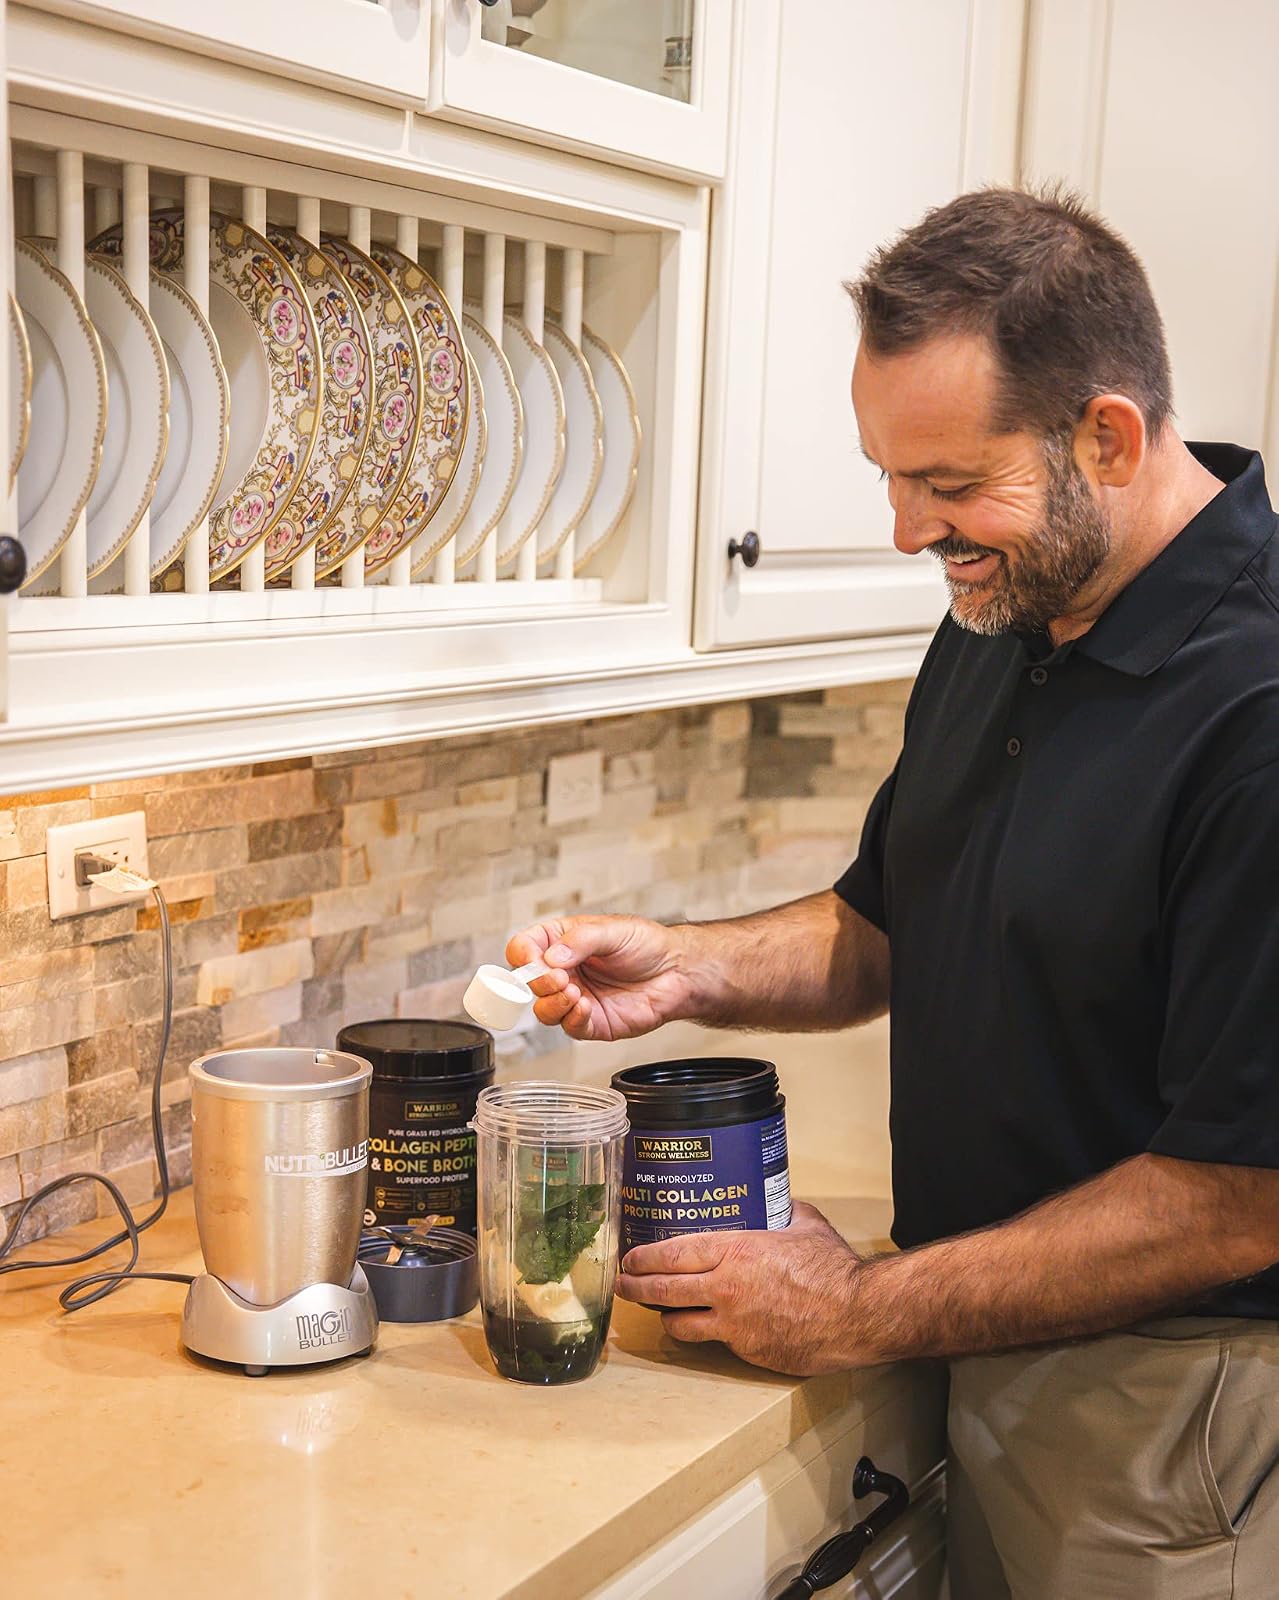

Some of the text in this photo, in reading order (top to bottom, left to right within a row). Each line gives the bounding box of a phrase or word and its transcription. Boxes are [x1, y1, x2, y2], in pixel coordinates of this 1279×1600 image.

[413, 1103, 457, 1112] WARRIOR
[388, 1129, 404, 1137] PURE
[406, 1129, 428, 1137] GRASS
[429, 1129, 441, 1137] FED
[369, 1137, 441, 1155] OLLAGEN
[642, 1140, 703, 1152] WARRIOR
[638, 1150, 709, 1160] STRONG WELLNESS
[371, 1157, 381, 1171] &
[384, 1158, 428, 1173] BONE
[396, 1176, 441, 1184] SUPERFOOD
[636, 1173, 714, 1184] PURE HYDROLYZED
[655, 1184, 748, 1204] COLLAGEN
[624, 1203, 741, 1221] PROTEIN POWDER
[299, 1332, 352, 1350] BULLET
